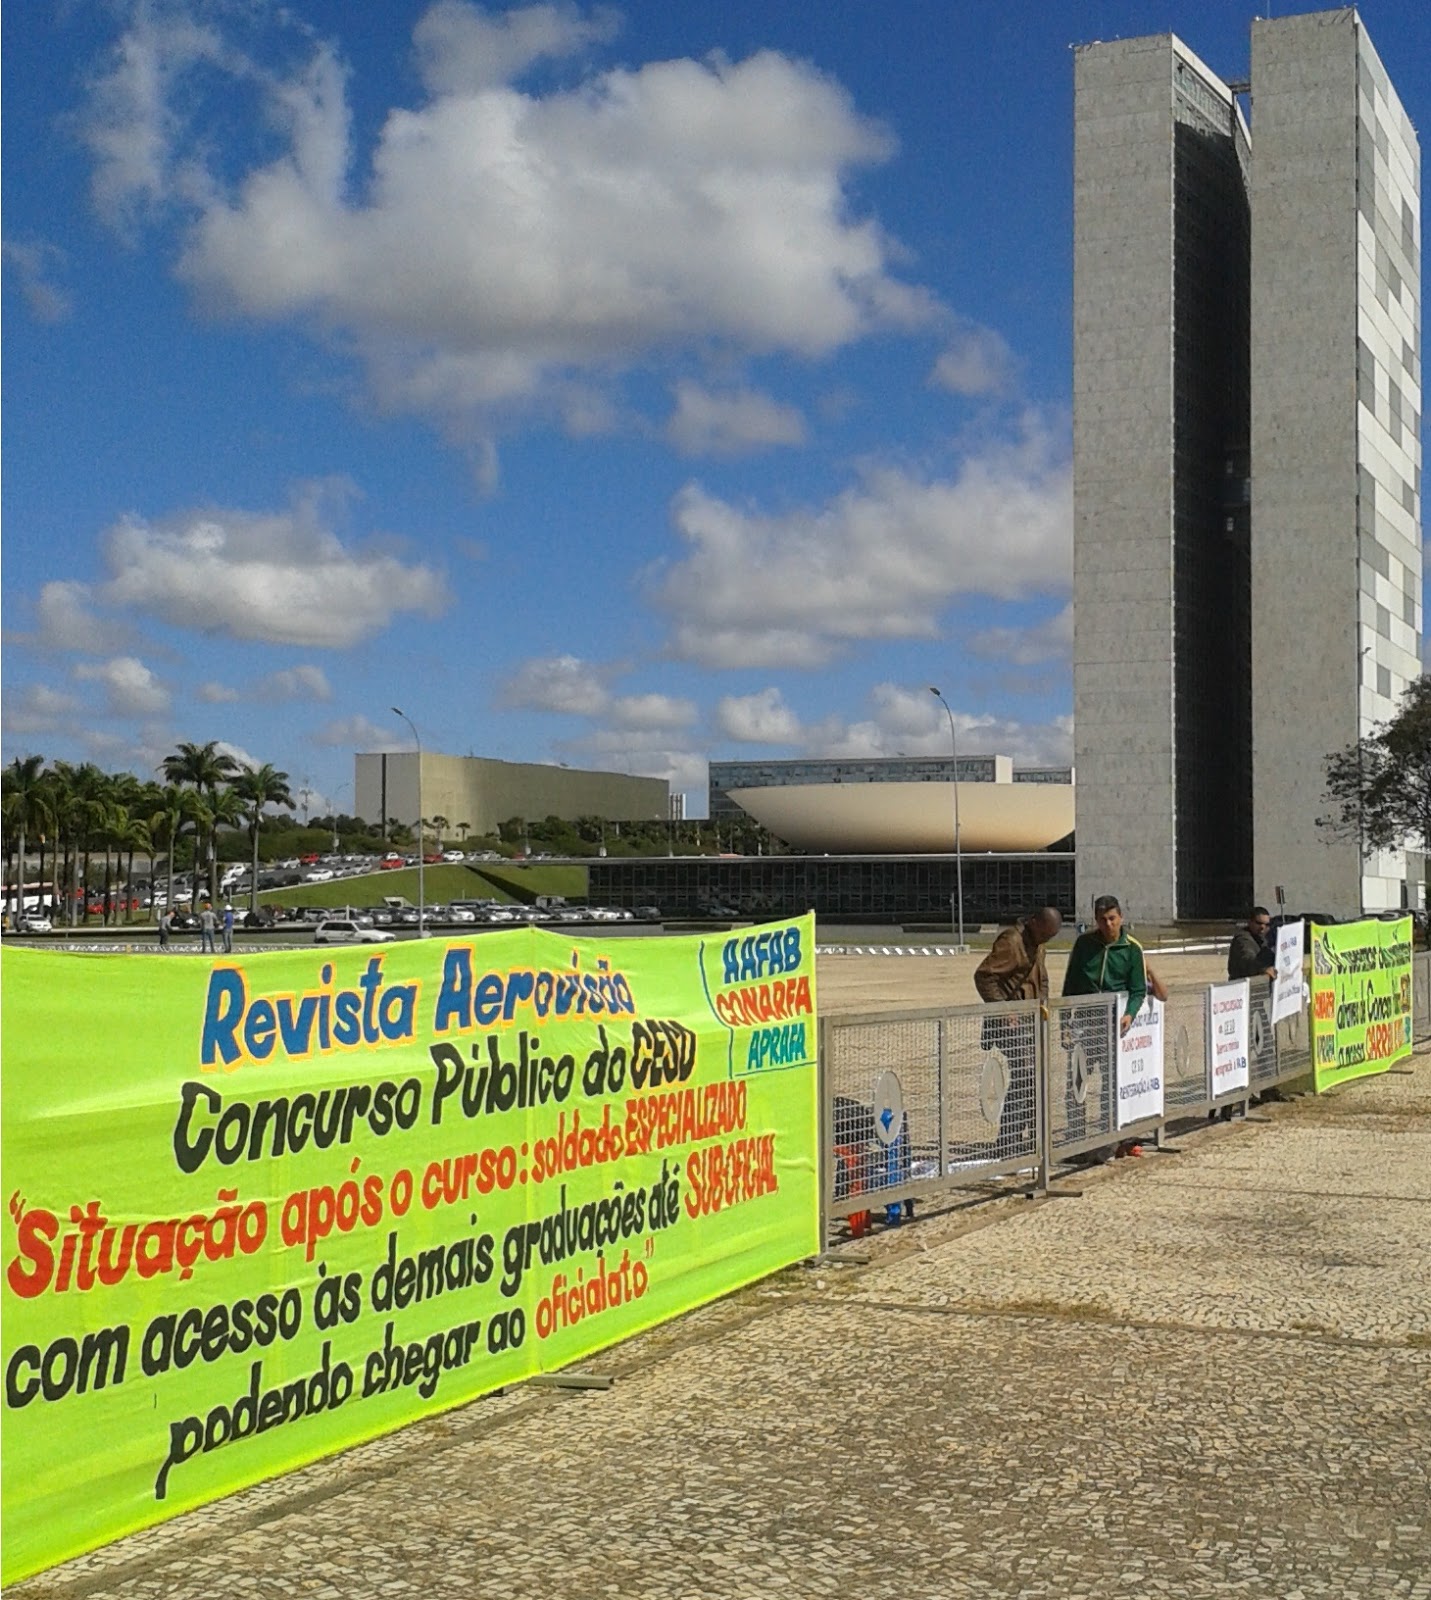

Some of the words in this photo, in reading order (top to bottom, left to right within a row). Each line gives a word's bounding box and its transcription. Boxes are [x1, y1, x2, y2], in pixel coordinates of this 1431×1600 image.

[200, 954, 420, 1071] Revista
[435, 944, 637, 1033] Aerovisão
[716, 976, 813, 1027] CONARFA
[722, 927, 802, 984] AAFAB
[173, 1079, 422, 1174] Concurso
[430, 1030, 574, 1125] Público
[582, 1024, 626, 1096] do
[630, 1018, 697, 1092] CESD
[747, 1022, 807, 1070] APRAFA
[280, 1157, 383, 1262] após
[390, 1168, 413, 1216] o
[421, 1142, 529, 1210] curso:
[531, 1103, 624, 1184] soldado
[6, 1324, 130, 1409] com
[141, 1287, 302, 1377] acesso
[313, 1261, 363, 1331] às
[371, 1213, 494, 1313] demais
[500, 1183, 645, 1298] graduações
[648, 1158, 680, 1232] até
[154, 1342, 354, 1500] podendo
[361, 1320, 481, 1400] chegar
[487, 1306, 525, 1354] ao
